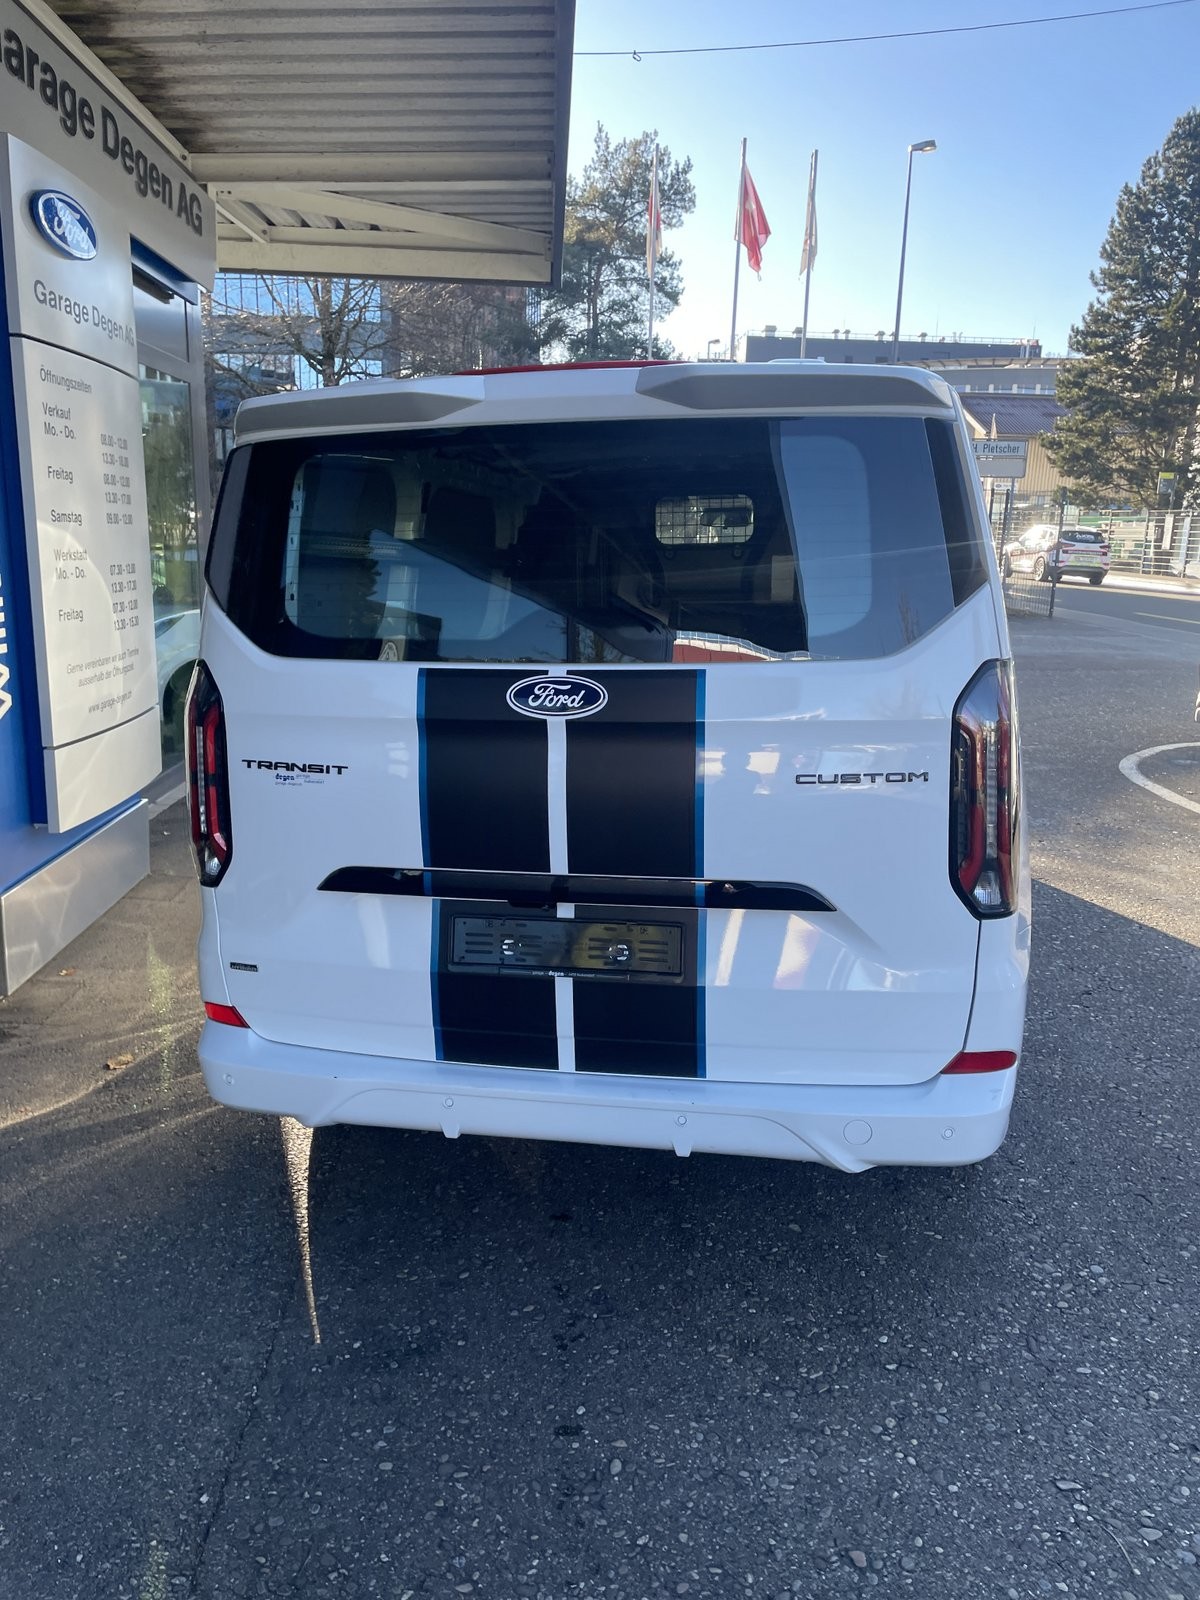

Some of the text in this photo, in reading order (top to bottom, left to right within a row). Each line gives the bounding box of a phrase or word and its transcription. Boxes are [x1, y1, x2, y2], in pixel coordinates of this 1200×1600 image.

[0, 28, 203, 237] arage Degen AG
[33, 279, 135, 347] Garage Degen AG
[39, 363, 92, 394] Öffnungszeiten
[42, 402, 71, 420] Verkauf
[44, 421, 58, 438] Mo.
[64, 425, 77, 440] Do.
[47, 465, 74, 484] Freitag
[50, 509, 83, 527] Samstag
[53, 548, 88, 561] Werkstatt
[55, 567, 69, 580] Mo.
[75, 566, 87, 579] Do.
[58, 608, 84, 623] Freitag
[528, 683, 586, 707] Ford
[241, 759, 349, 775] TRANSIT
[795, 772, 929, 785] CUSTOM
